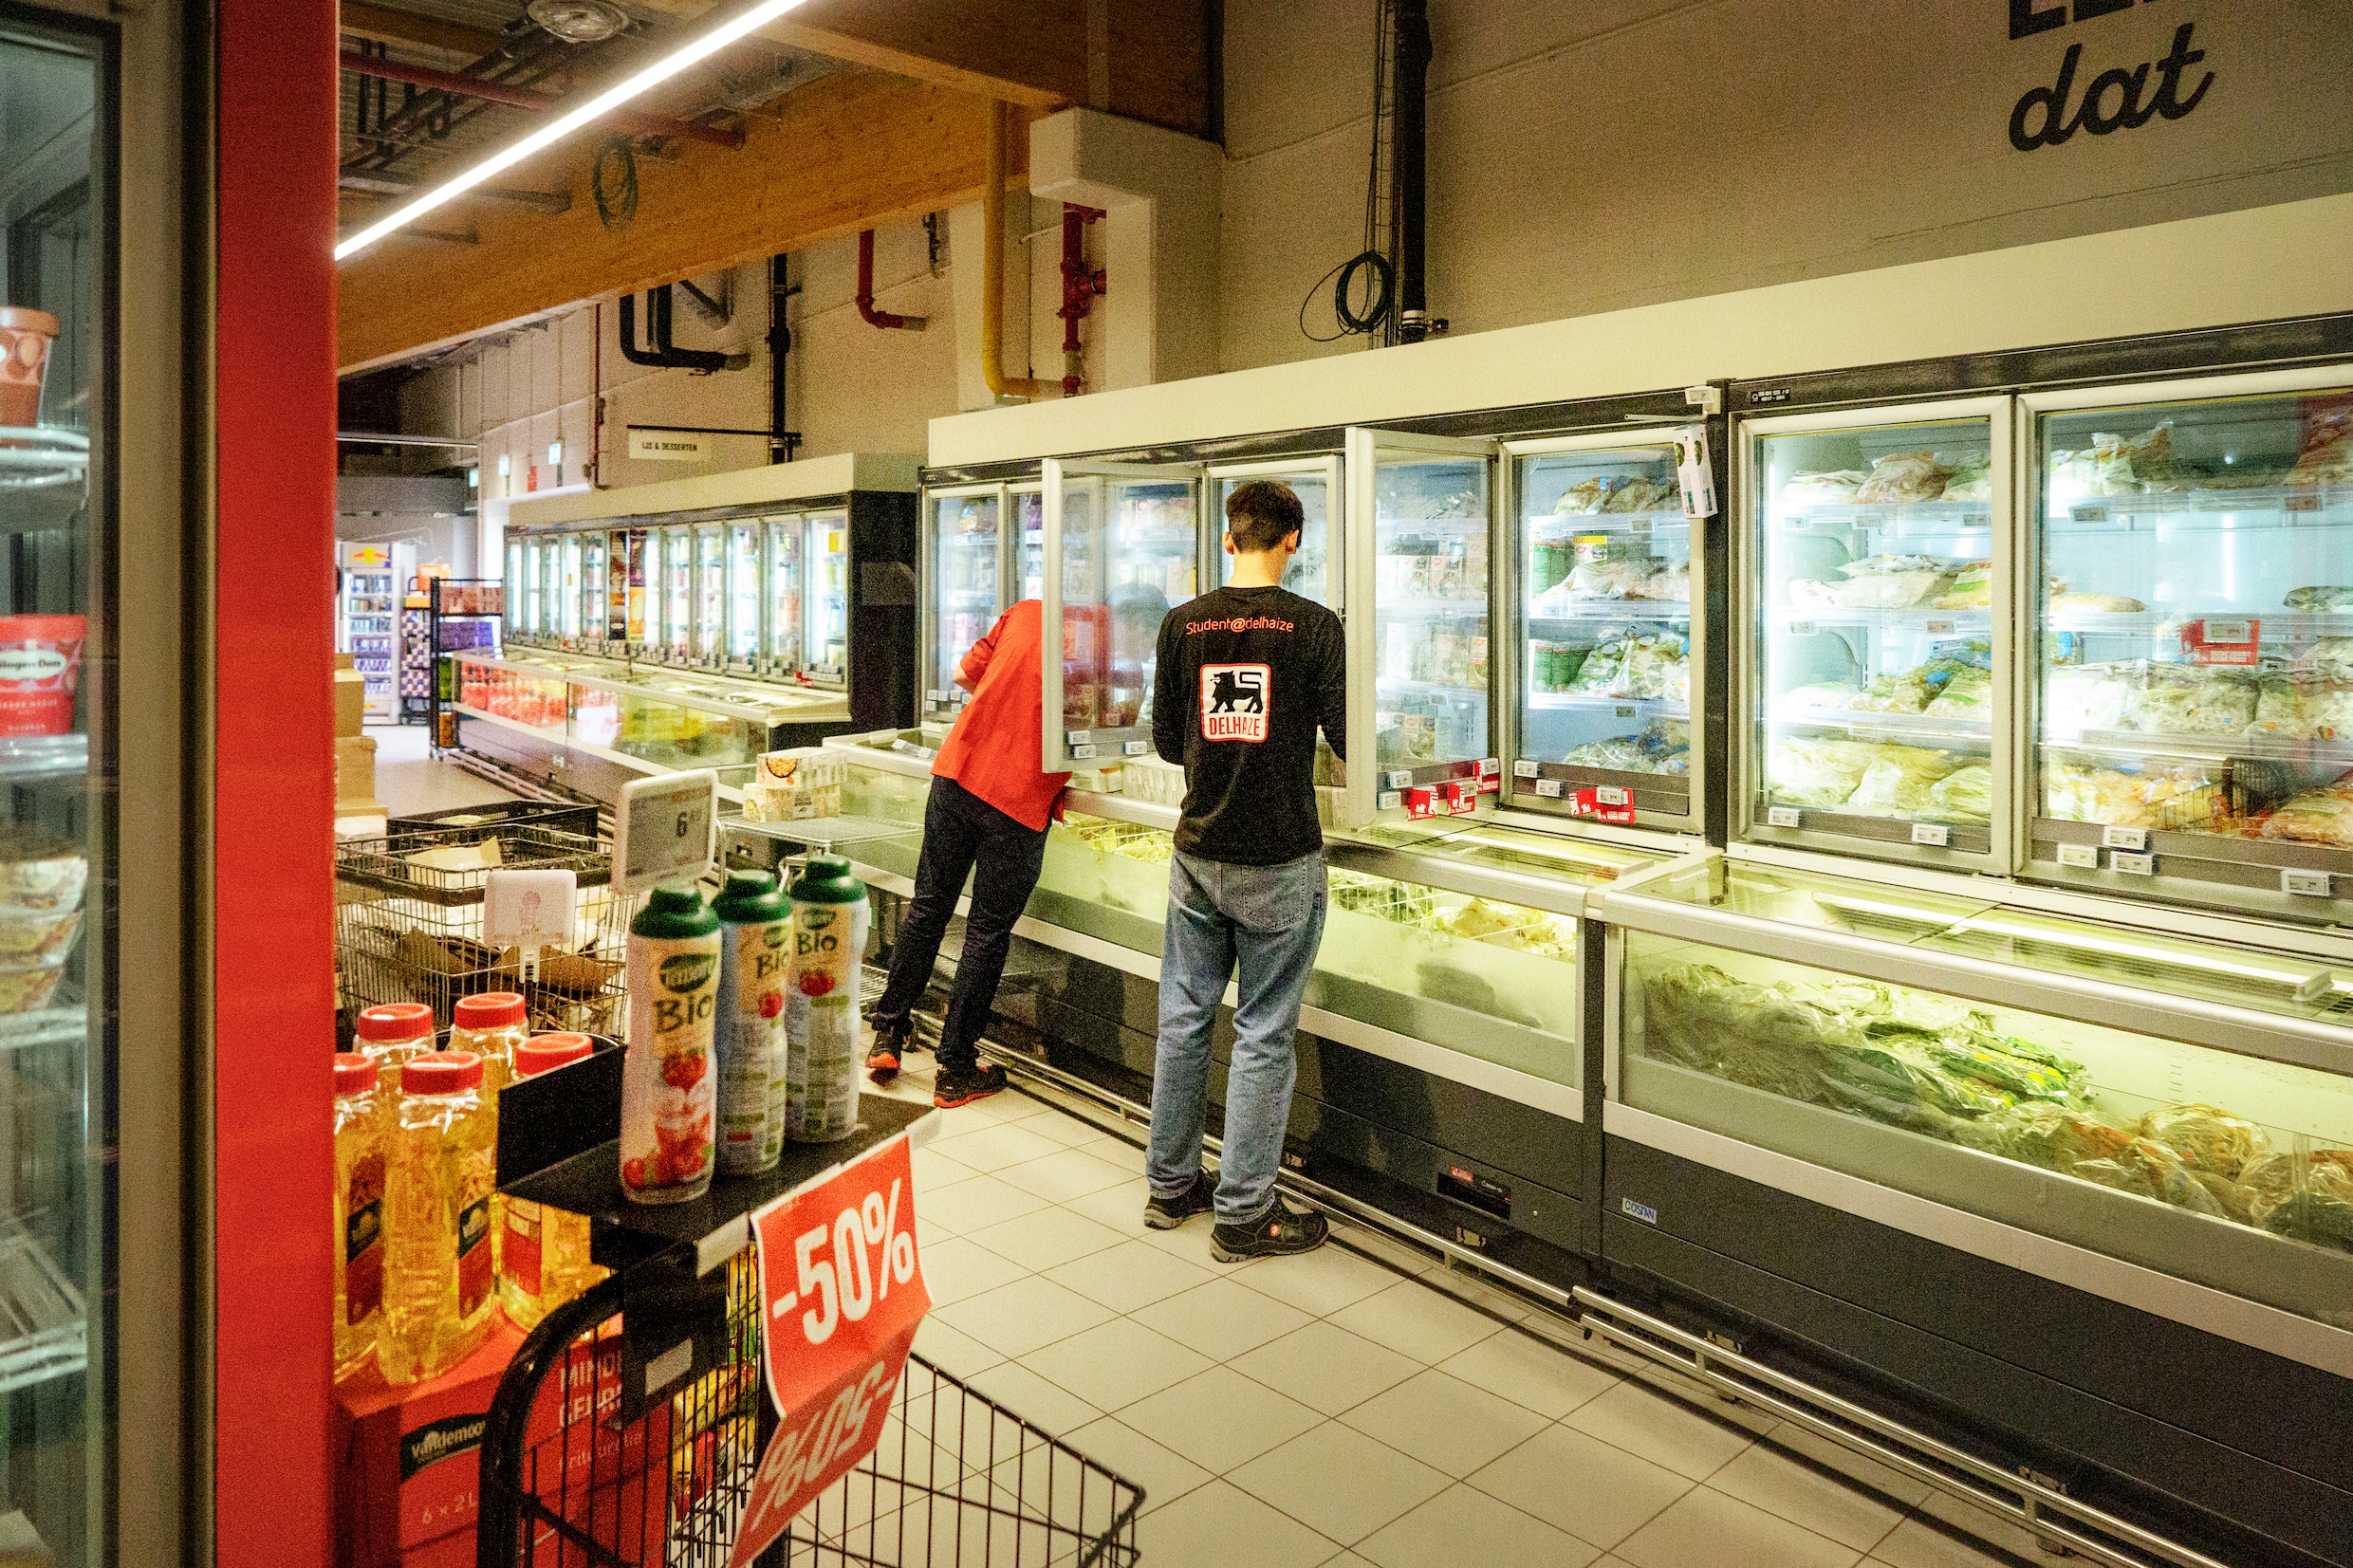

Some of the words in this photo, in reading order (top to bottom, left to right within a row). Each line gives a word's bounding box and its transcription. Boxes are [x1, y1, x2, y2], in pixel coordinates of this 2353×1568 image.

[2009, 22, 2215, 152] dat
[661, 442, 697, 452] DESSERTEN
[1186, 617, 1294, 635] Student@delhaize
[1624, 1200, 1655, 1220] COSTAN
[773, 1178, 916, 1345] -50%
[560, 1351, 622, 1393] MIND
